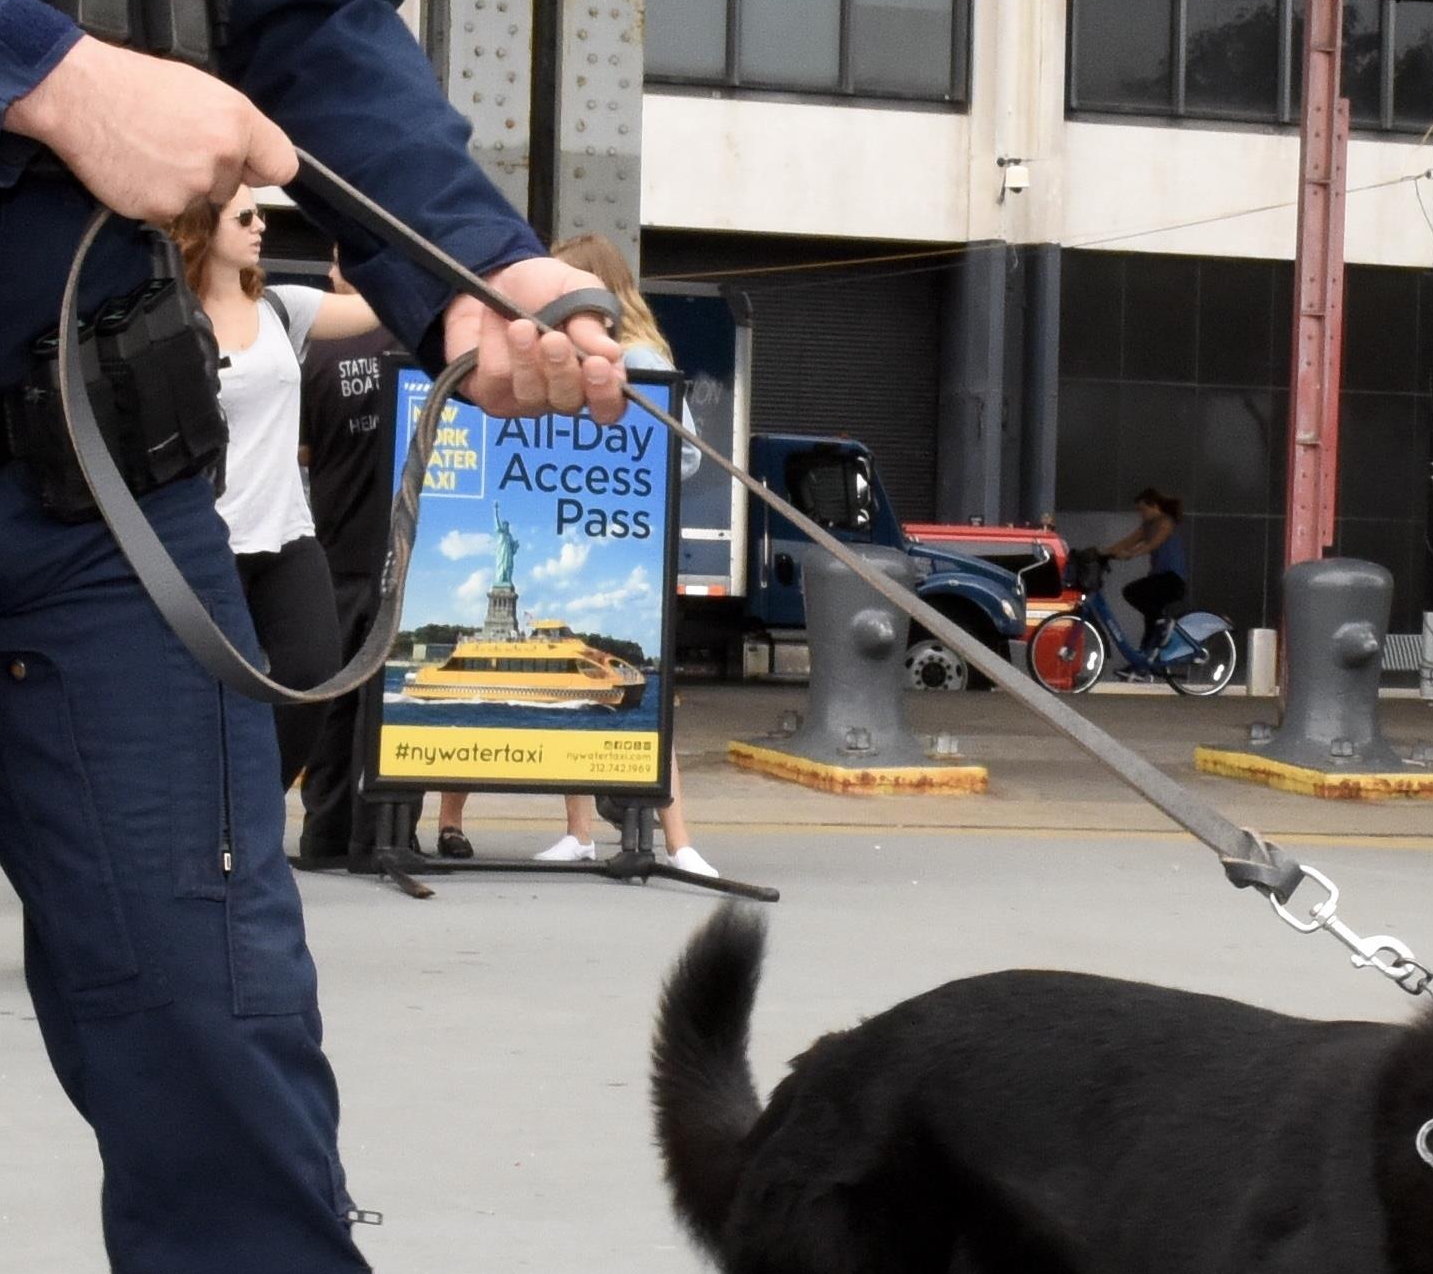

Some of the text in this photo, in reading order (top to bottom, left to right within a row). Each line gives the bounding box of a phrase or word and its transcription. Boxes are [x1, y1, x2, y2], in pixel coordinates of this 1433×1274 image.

[338, 357, 379, 378] STATUE
[495, 413, 654, 462] All-Day
[428, 451, 477, 470] ATER
[423, 472, 455, 490] AXI
[499, 453, 652, 496] Access
[557, 498, 651, 539] Pass
[395, 742, 543, 766] #nywatertaxi
[567, 750, 652, 762] nywatertaxi.com
[590, 762, 652, 773] 212.742.1969
